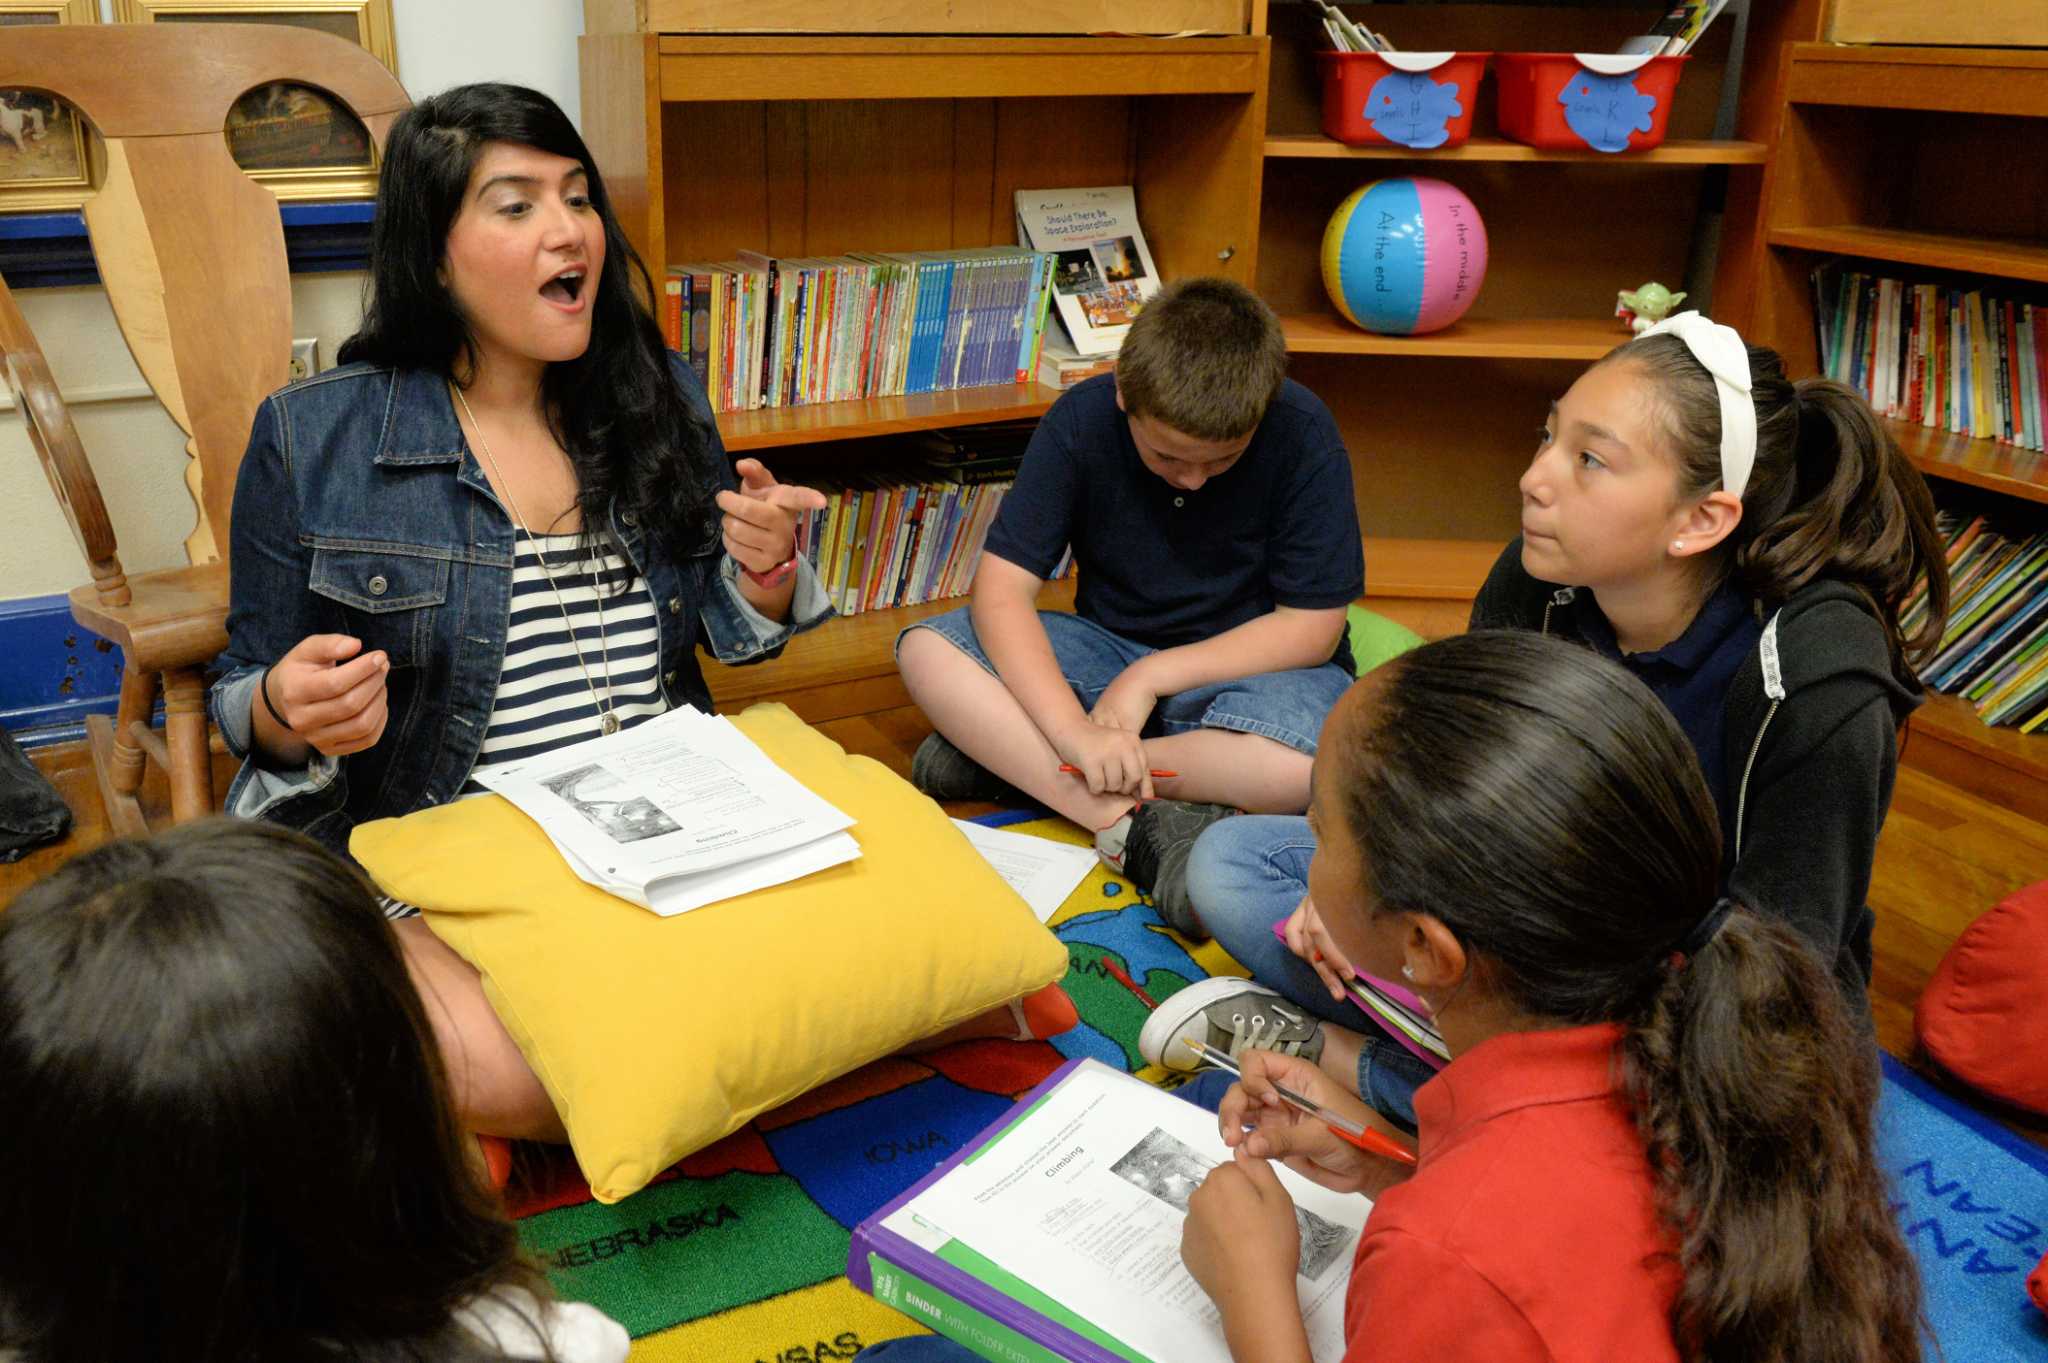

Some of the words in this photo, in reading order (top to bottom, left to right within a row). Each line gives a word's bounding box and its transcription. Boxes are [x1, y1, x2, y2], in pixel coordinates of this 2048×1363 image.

[1410, 100, 1421, 118] H
[1607, 99, 1619, 121] K
[1602, 127, 1617, 144] L
[1046, 213, 1073, 225] Should
[1073, 210, 1096, 221] There
[1096, 208, 1108, 218] Be
[1376, 211, 1396, 230] At
[1448, 204, 1462, 218] In
[1456, 223, 1470, 246] the
[1044, 225, 1069, 237] Space
[1375, 236, 1392, 260] the
[863, 1128, 951, 1168] IOWA
[1045, 1145, 1085, 1178] Climbing
[905, 1291, 943, 1319] BINDER
[943, 1312, 969, 1333] WITH
[970, 1327, 1004, 1353] FOLDER
